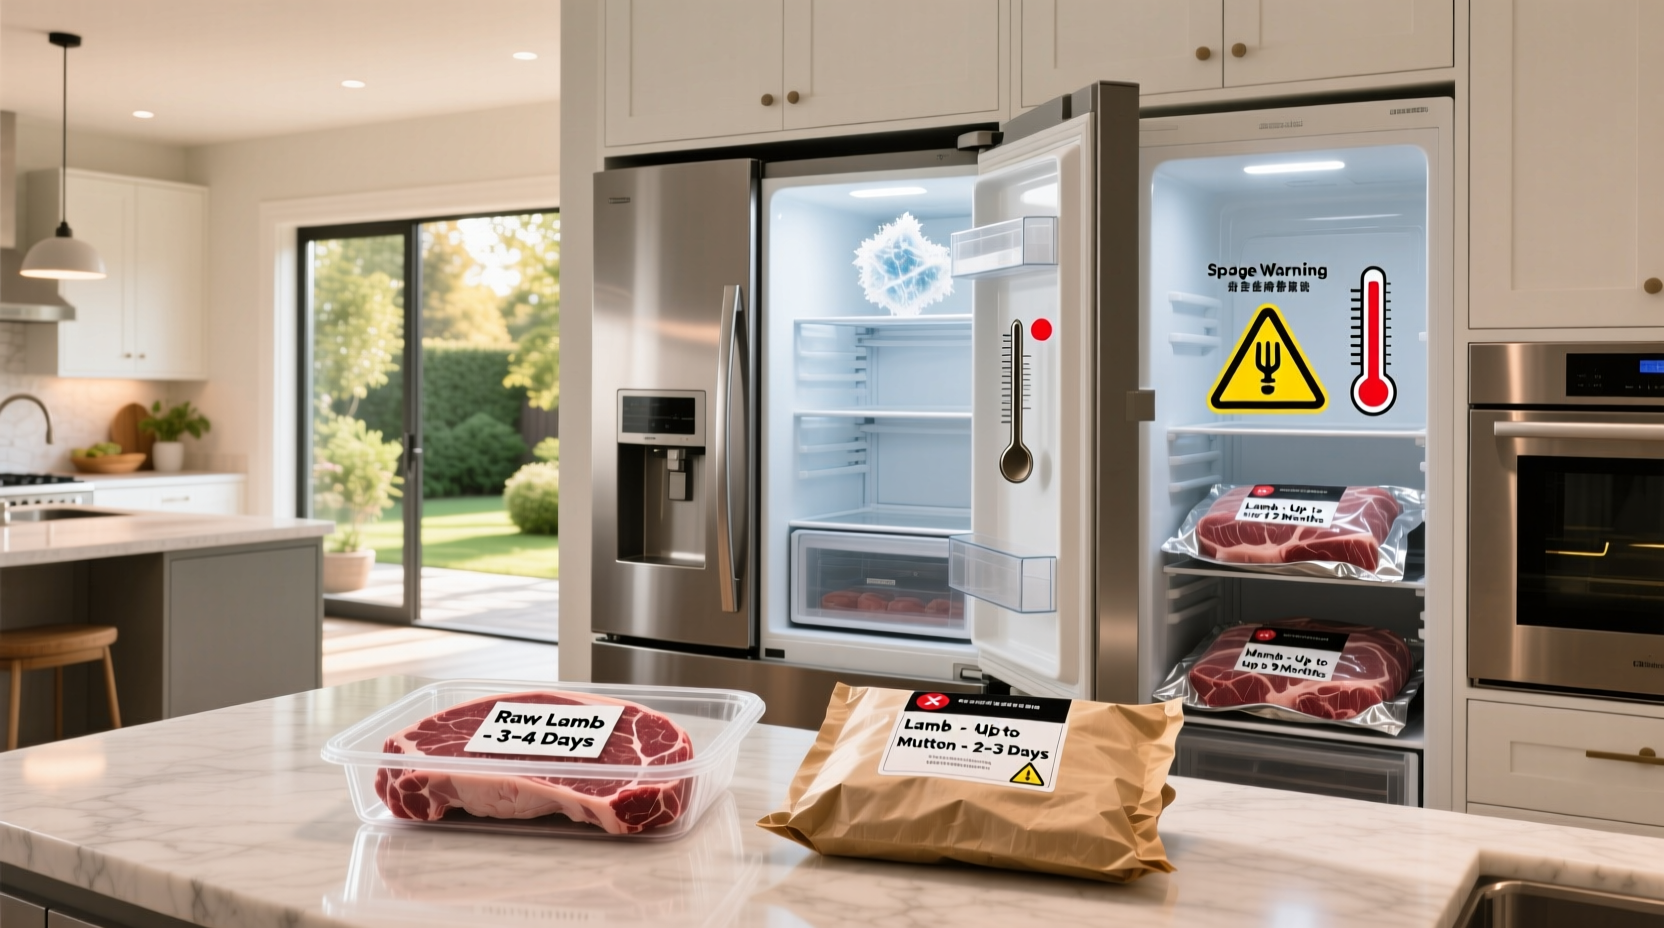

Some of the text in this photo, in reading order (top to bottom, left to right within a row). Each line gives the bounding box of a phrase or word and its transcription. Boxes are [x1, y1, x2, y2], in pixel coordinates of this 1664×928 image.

[1260, 262, 1328, 280] Warning
[494, 710, 605, 729] Raw Lamb
[904, 718, 952, 733] Lamb
[496, 729, 537, 745] 3-4
[540, 732, 595, 752] Days
[896, 736, 956, 751] Mutton
[972, 742, 1004, 755] 2-3
[1007, 745, 1049, 761] Days
